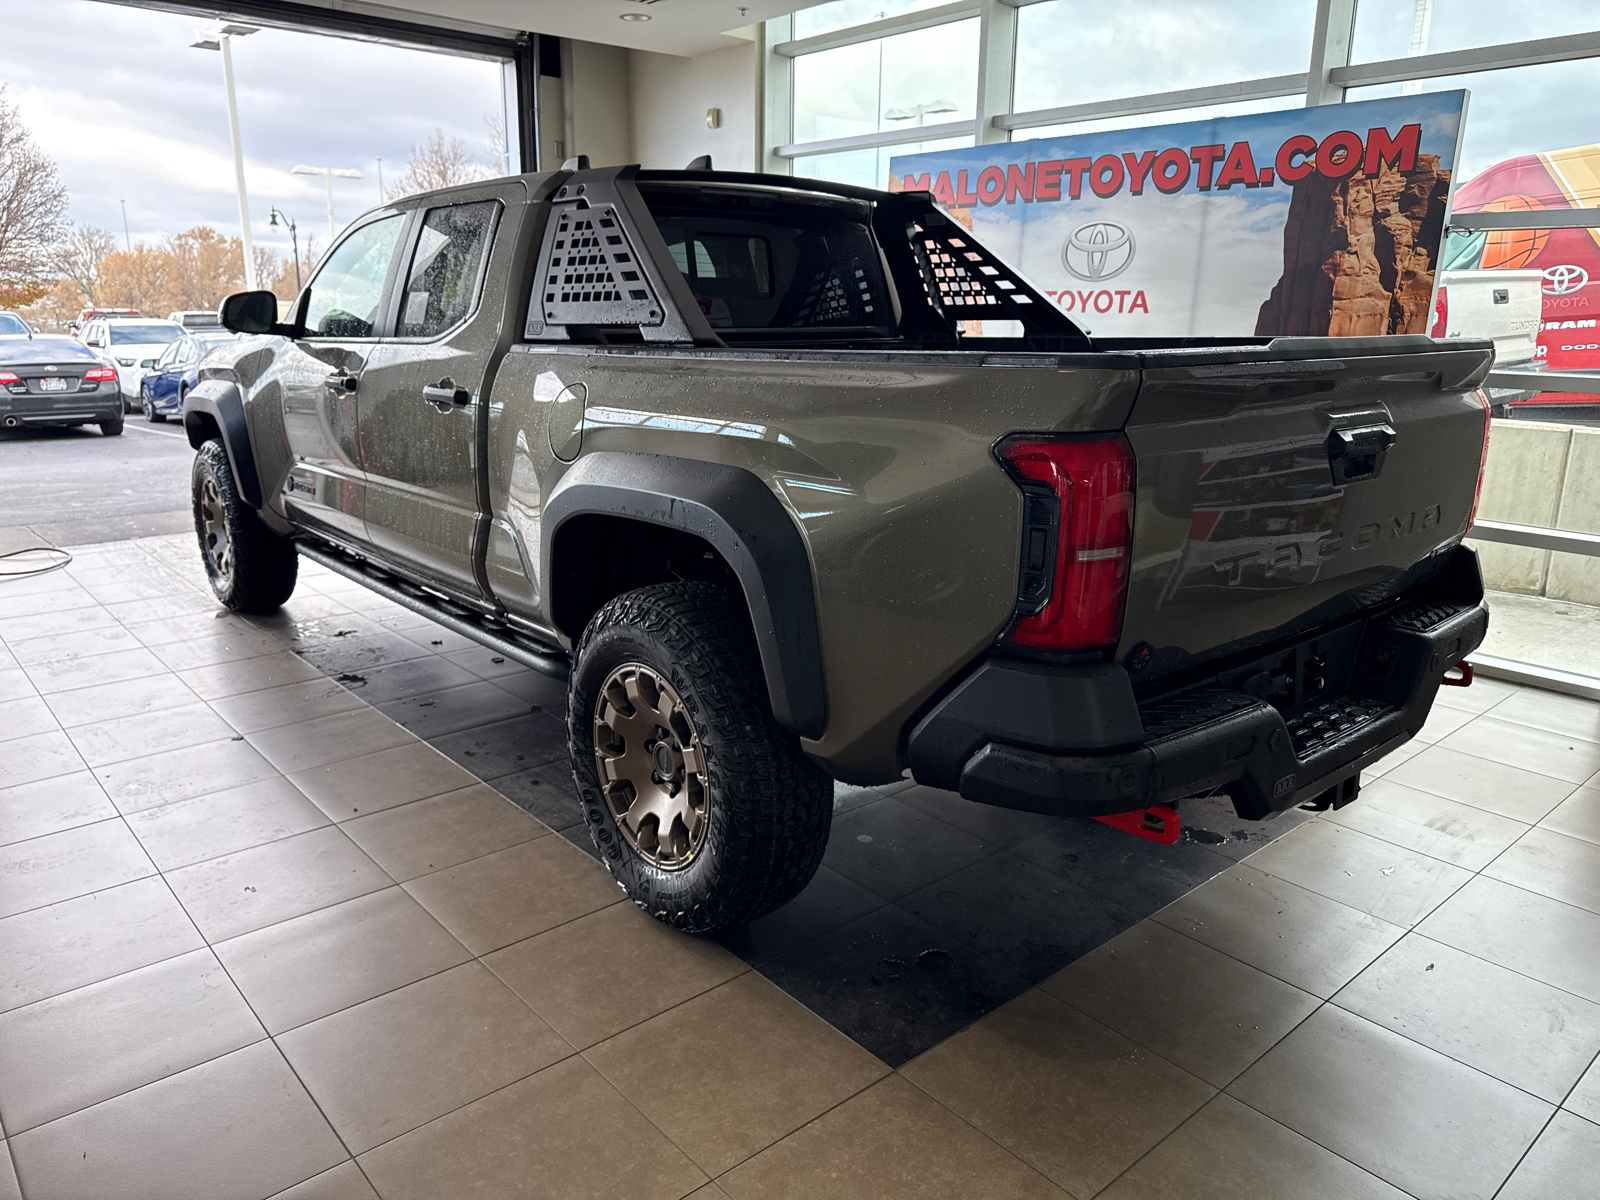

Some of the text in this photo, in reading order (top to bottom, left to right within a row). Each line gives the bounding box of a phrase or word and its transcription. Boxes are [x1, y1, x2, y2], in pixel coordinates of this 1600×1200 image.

[904, 123, 1421, 208] MALONETOYOTA.COM
[1543, 297, 1589, 310] OYOTA
[1546, 319, 1597, 330] RAM
[1214, 504, 1441, 587] TACOMA
[1275, 775, 1295, 796] ARB
